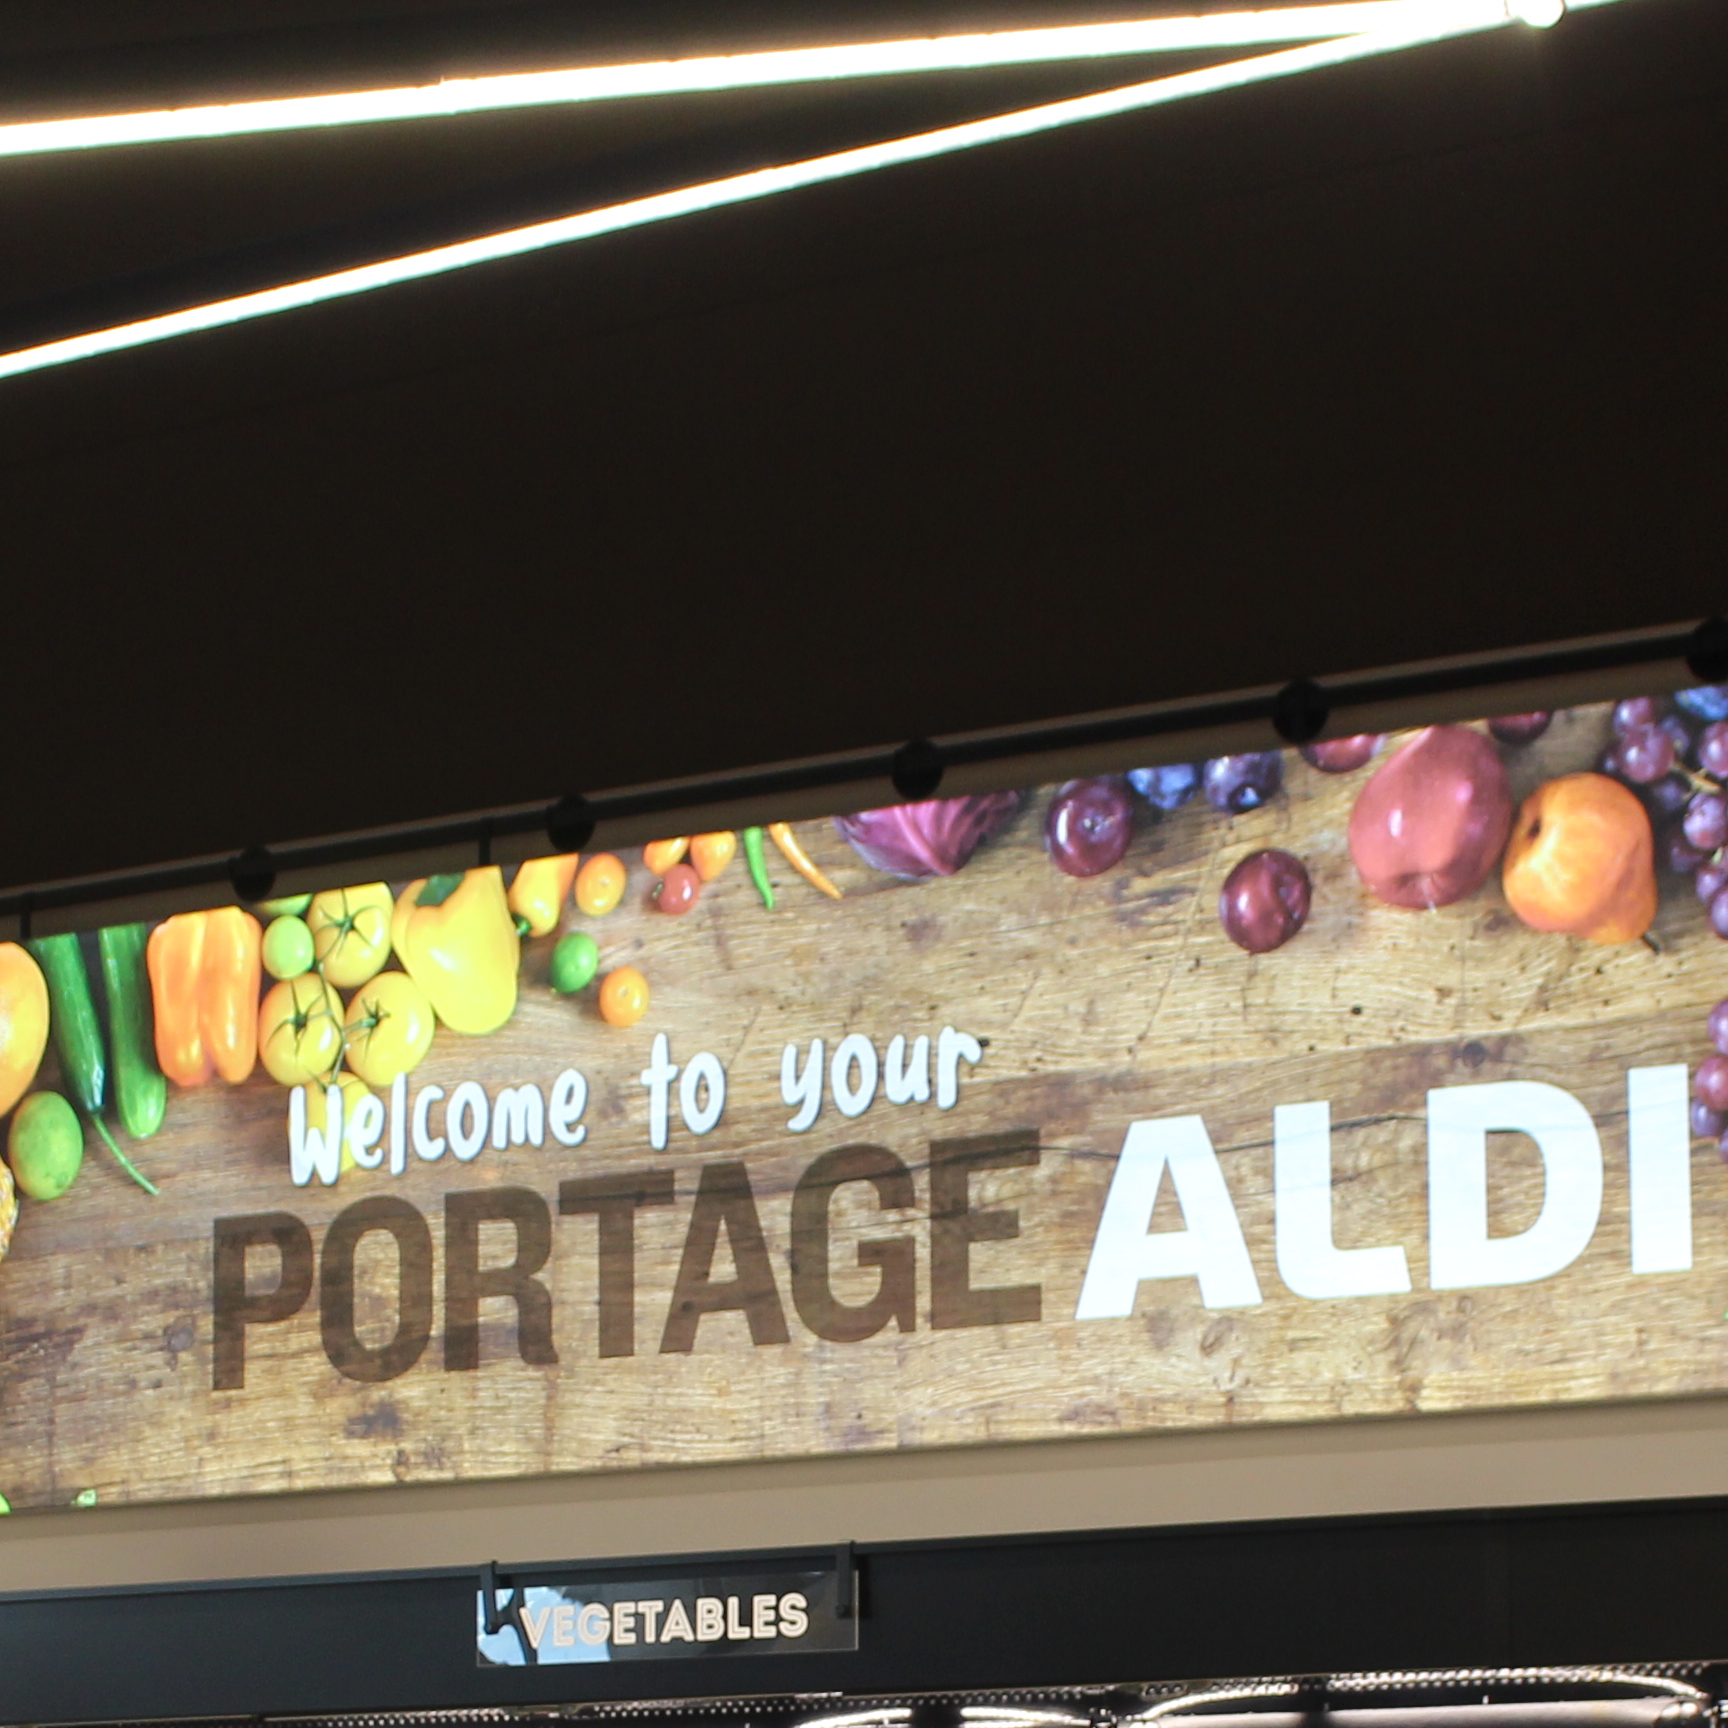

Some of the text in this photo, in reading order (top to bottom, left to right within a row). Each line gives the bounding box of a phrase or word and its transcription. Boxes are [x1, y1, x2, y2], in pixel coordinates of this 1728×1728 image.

[288, 1026, 985, 1186] Welcome to your
[212, 1062, 1694, 1391] PORTAGE ALDI
[519, 1592, 809, 1650] VEGETABLES
